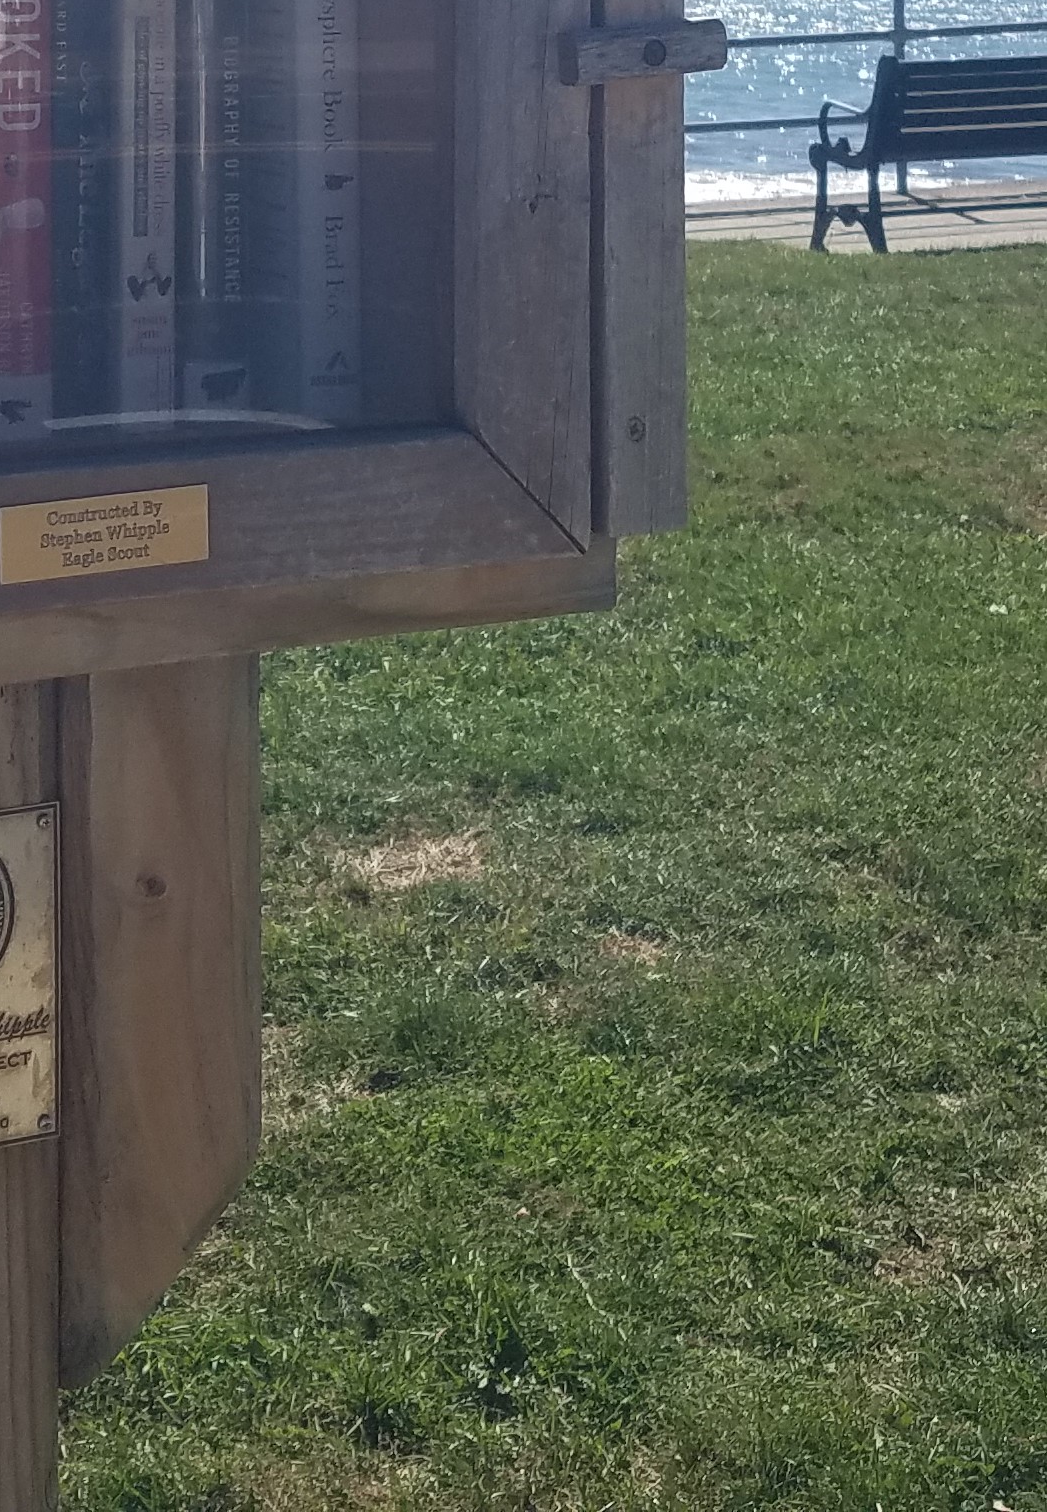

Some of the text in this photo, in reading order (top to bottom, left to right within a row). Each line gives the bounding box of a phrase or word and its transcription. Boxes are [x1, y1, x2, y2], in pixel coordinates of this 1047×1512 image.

[55, 41, 68, 84] FAST
[322, 89, 344, 153] Book
[154, 146, 171, 187] white
[223, 35, 241, 303] BIOGRAPHY OF RESISTANCE
[324, 215, 346, 270] Brad
[46, 500, 163, 526] Constructed By
[40, 519, 170, 550] Stephen Whipple
[61, 543, 150, 568] Eagle Scout
